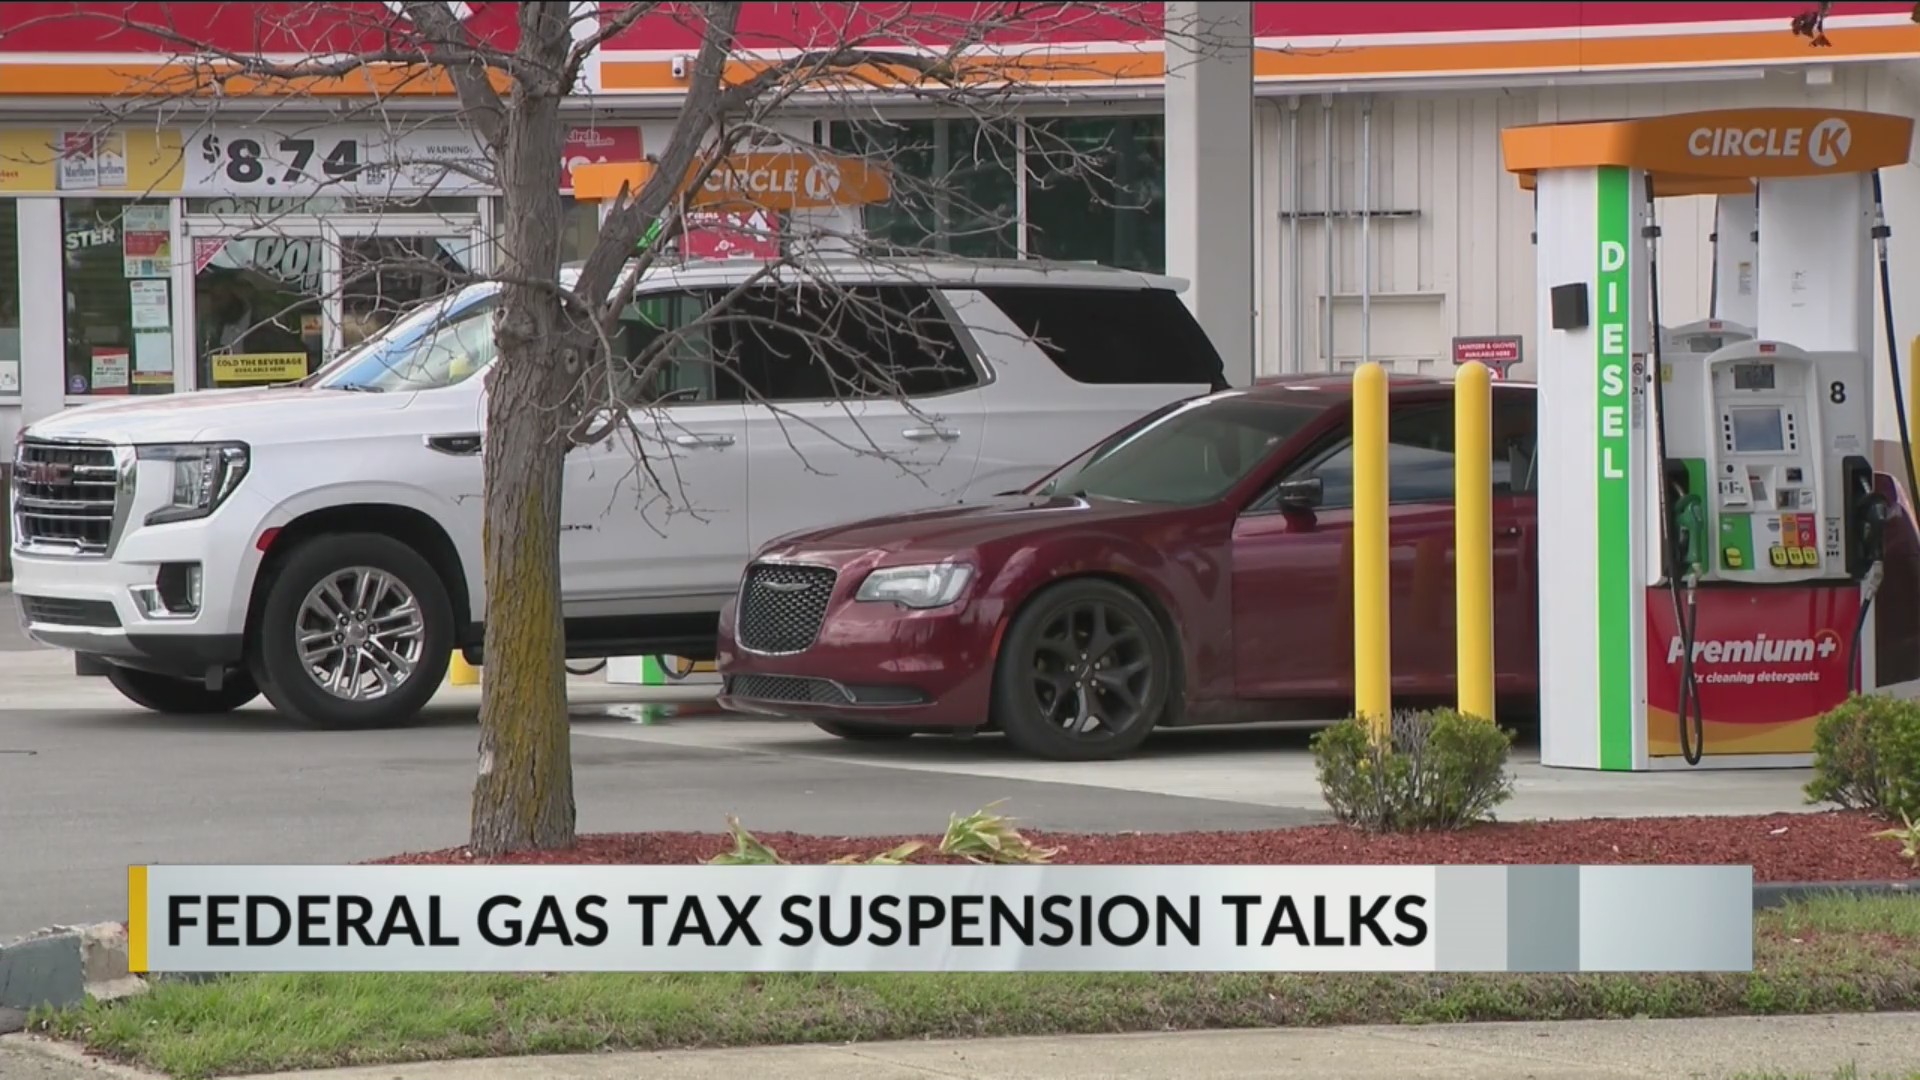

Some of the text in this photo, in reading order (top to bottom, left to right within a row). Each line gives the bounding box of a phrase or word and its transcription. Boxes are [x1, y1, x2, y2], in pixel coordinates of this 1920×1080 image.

[1687, 127, 1804, 157] CIRCLE
[202, 133, 361, 185] $8.74
[703, 168, 799, 193] CIRCLE
[65, 227, 116, 250] STER
[1601, 240, 1626, 479] DIESEL
[1830, 381, 1847, 404] 8
[1706, 671, 1755, 684] cleaning
[1757, 670, 1820, 684] detergents
